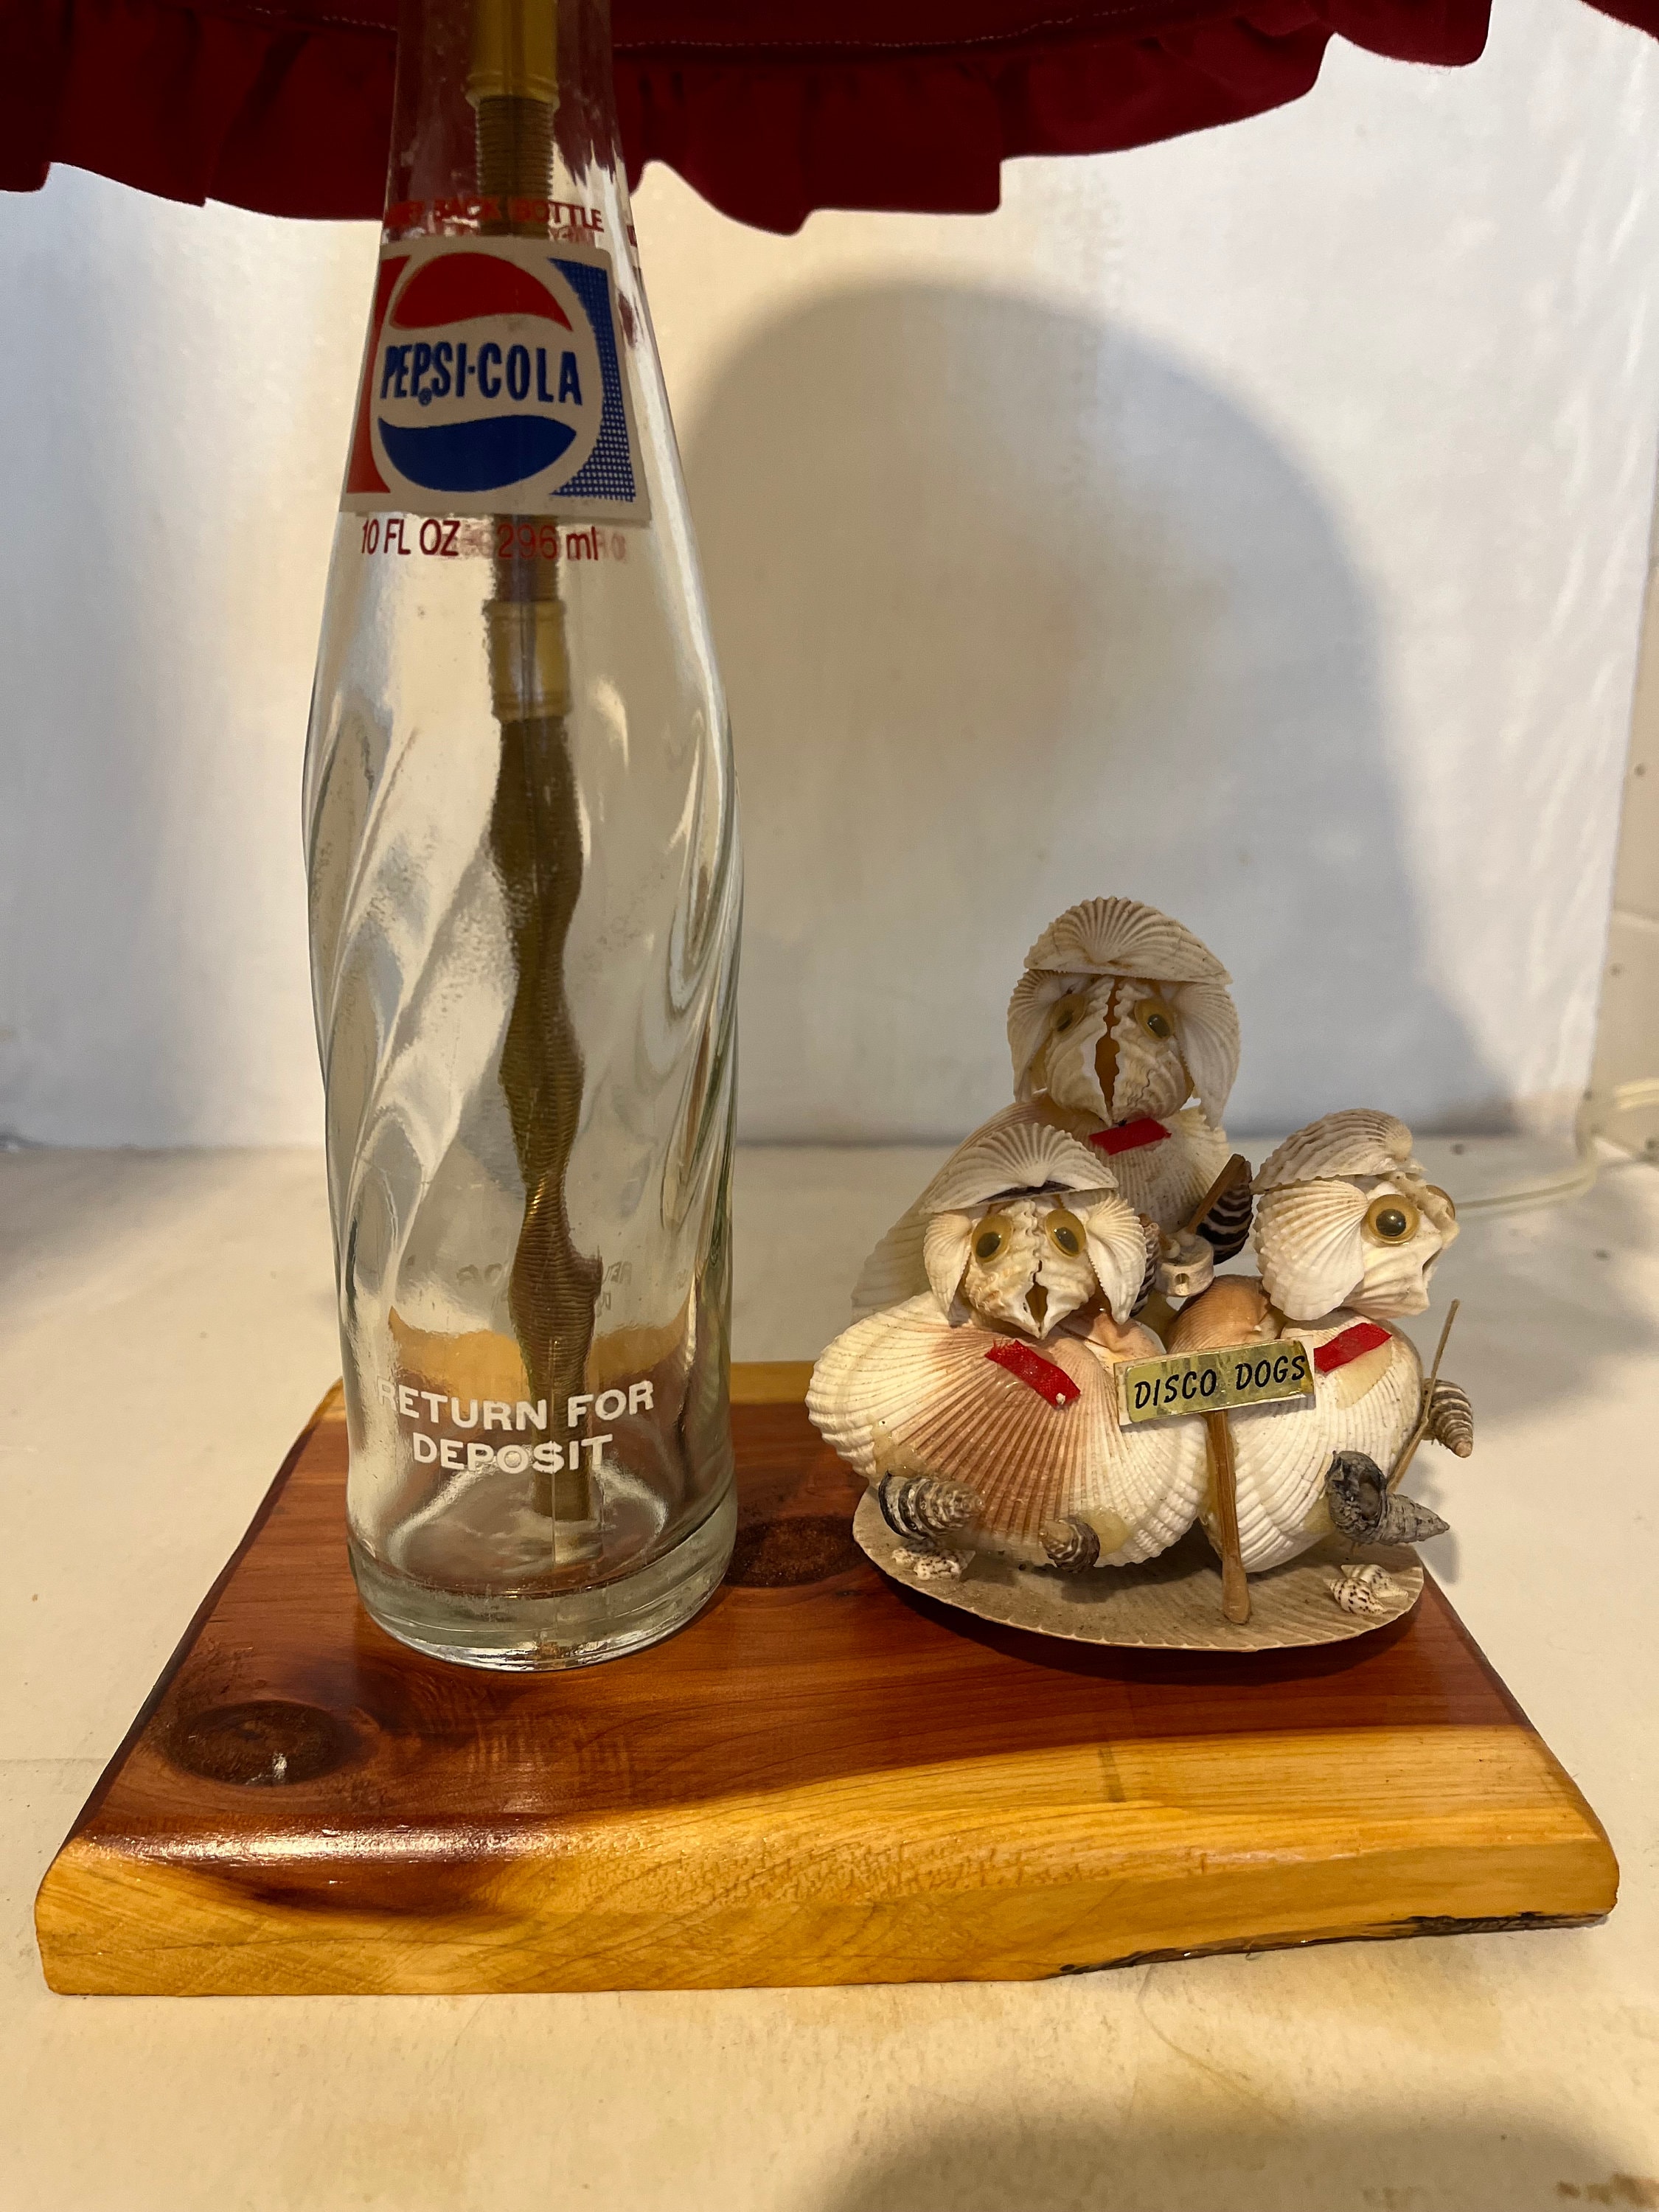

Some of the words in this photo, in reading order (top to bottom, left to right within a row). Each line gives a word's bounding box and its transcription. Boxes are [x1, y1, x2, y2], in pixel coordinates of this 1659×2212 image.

[380, 341, 582, 406] PEPSI-COLA
[361, 518, 380, 554] 10
[384, 518, 411, 554] FL
[420, 518, 461, 556] OZ
[497, 523, 558, 560] 296
[566, 526, 599, 560] ml
[377, 1375, 547, 1431] RETURN
[567, 1380, 654, 1428] FOR
[1134, 1368, 1217, 1410] DISCO
[1235, 1355, 1306, 1391] DOGS
[412, 1432, 613, 1475] DEPOSIT
